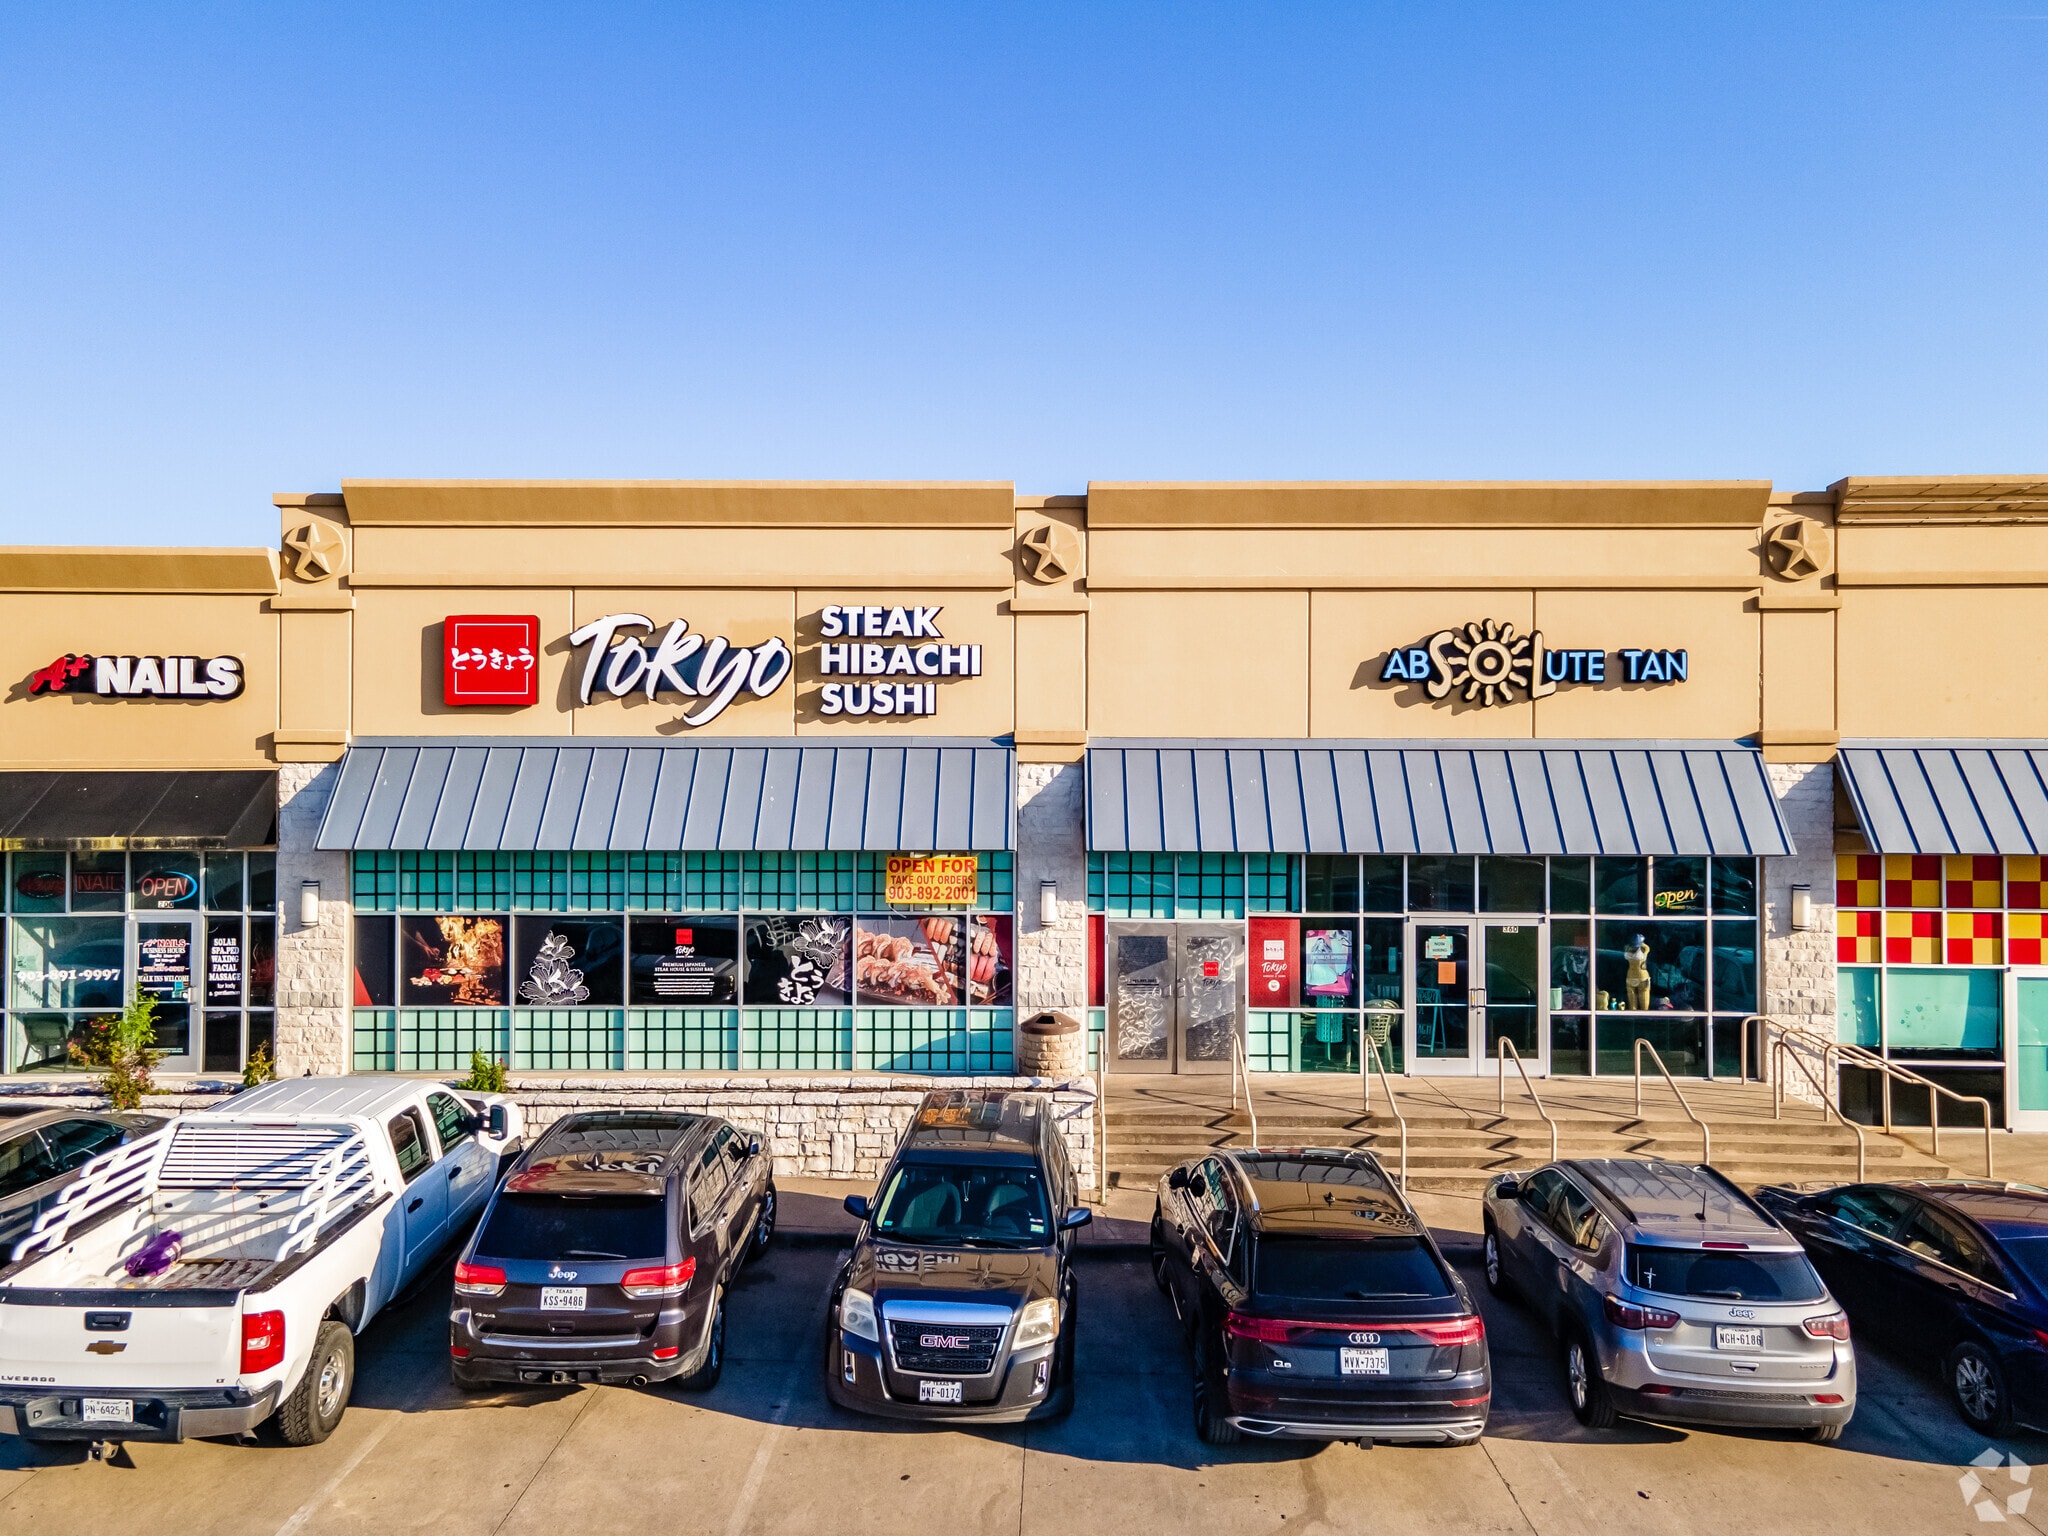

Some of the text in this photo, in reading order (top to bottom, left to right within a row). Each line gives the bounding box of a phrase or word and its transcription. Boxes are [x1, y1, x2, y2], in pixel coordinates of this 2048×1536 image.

[820, 605, 944, 638] STEAK
[820, 643, 982, 676] HIBACHI
[1623, 649, 1688, 682] TAN
[97, 657, 241, 695] NAILS
[570, 613, 792, 727] Tokyo
[820, 683, 936, 715] SUSHI
[888, 859, 975, 873] OPEN FOR
[141, 877, 188, 897] OPEN
[891, 875, 973, 885] TAKE OUT ORDERS
[888, 886, 976, 900] 903-892-2001
[157, 939, 186, 948] NAILS
[214, 938, 237, 946] SOLAR
[675, 946, 695, 957] Tokyo
[211, 955, 239, 963] WAXING
[213, 964, 238, 972] FACIAL
[1261, 961, 1287, 975] Tokyo
[208, 972, 241, 981] MASSAGE
[548, 1266, 578, 1281] Jeep
[1729, 1307, 1755, 1319] Jeep
[920, 1334, 970, 1348] GMC
